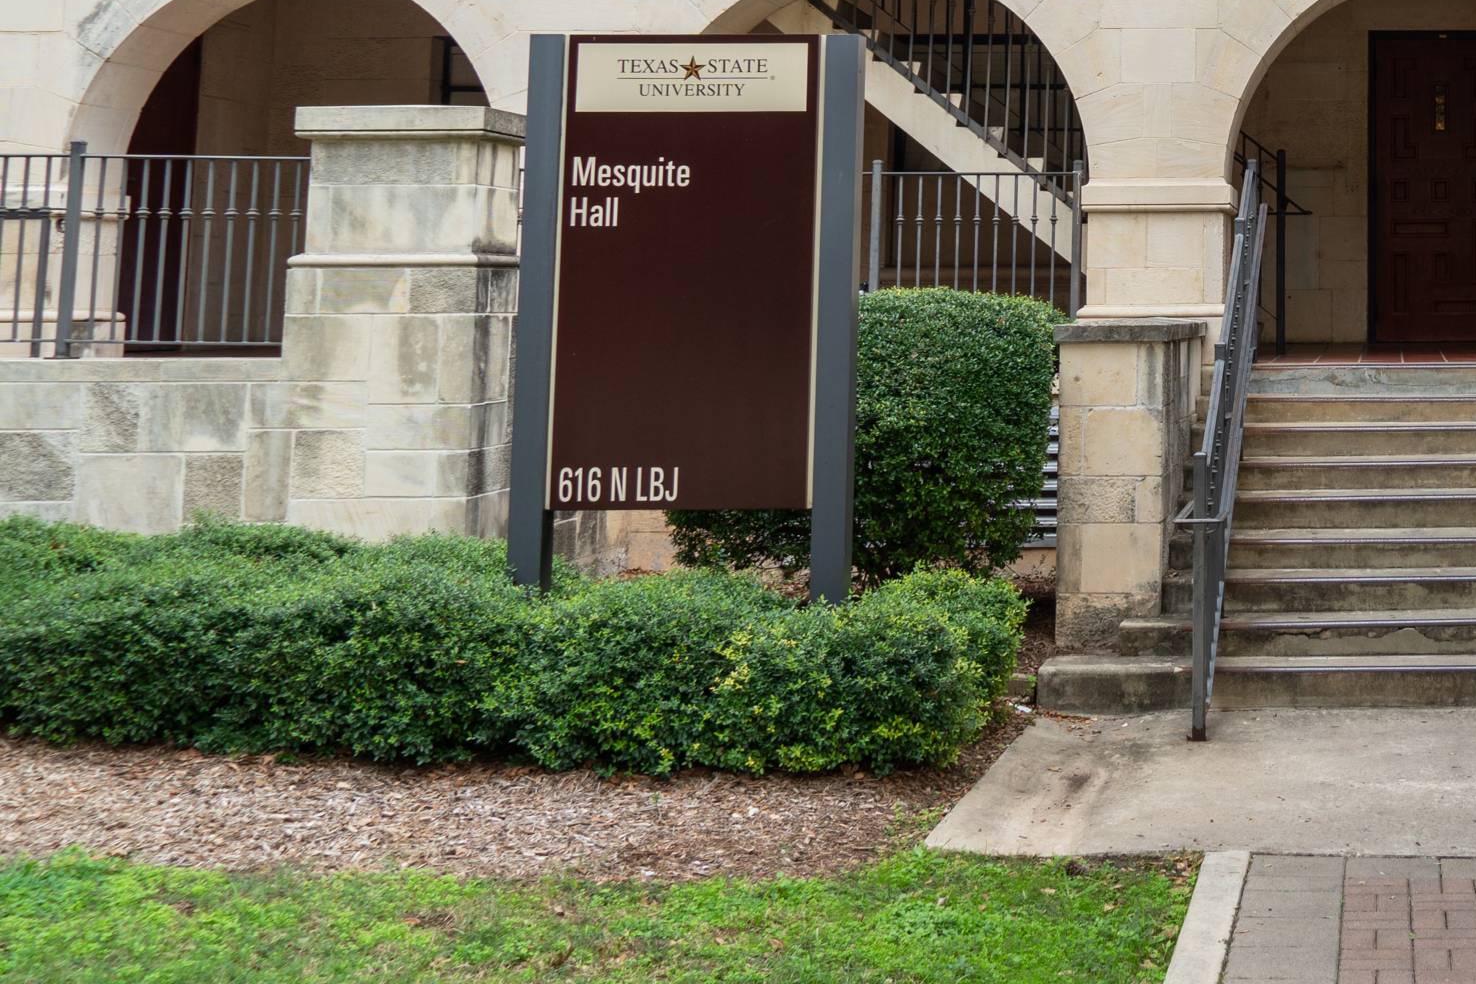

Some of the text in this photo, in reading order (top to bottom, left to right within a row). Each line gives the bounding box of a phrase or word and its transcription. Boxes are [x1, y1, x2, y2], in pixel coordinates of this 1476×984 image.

[617, 58, 768, 74] TEXAS STATE
[639, 83, 745, 97] UNIVERSITY
[571, 156, 691, 194] Mesquite
[569, 196, 619, 227] Hall
[558, 466, 679, 503] 616 N LBJ
